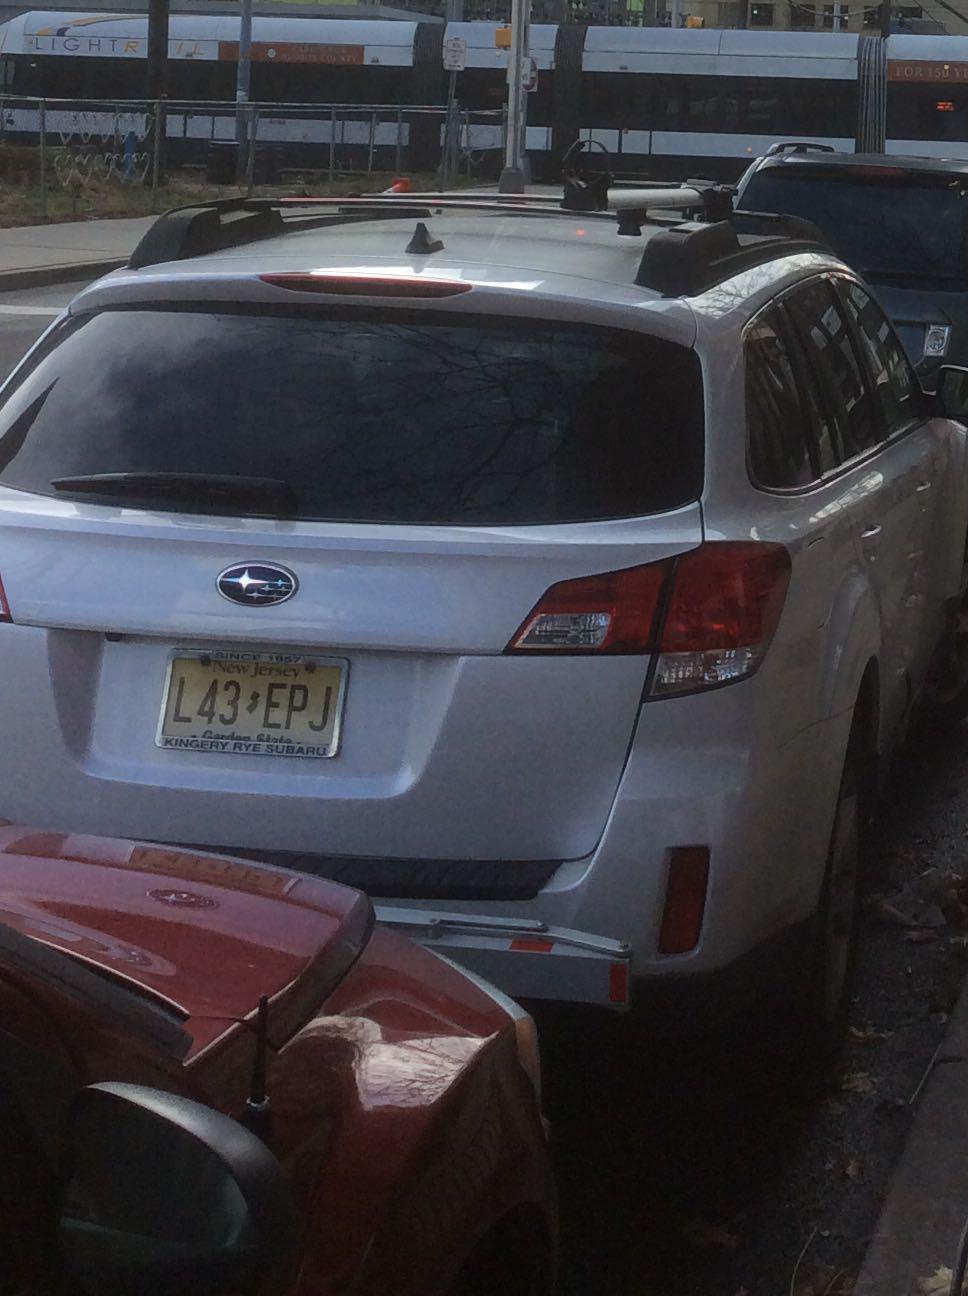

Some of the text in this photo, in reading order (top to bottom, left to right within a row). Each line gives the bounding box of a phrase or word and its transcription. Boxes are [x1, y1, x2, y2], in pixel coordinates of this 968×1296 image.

[212, 660, 300, 679] New Jersey
[173, 676, 333, 732] L43 EPJ
[164, 737, 329, 755] KINGERY RYE SUBARU
